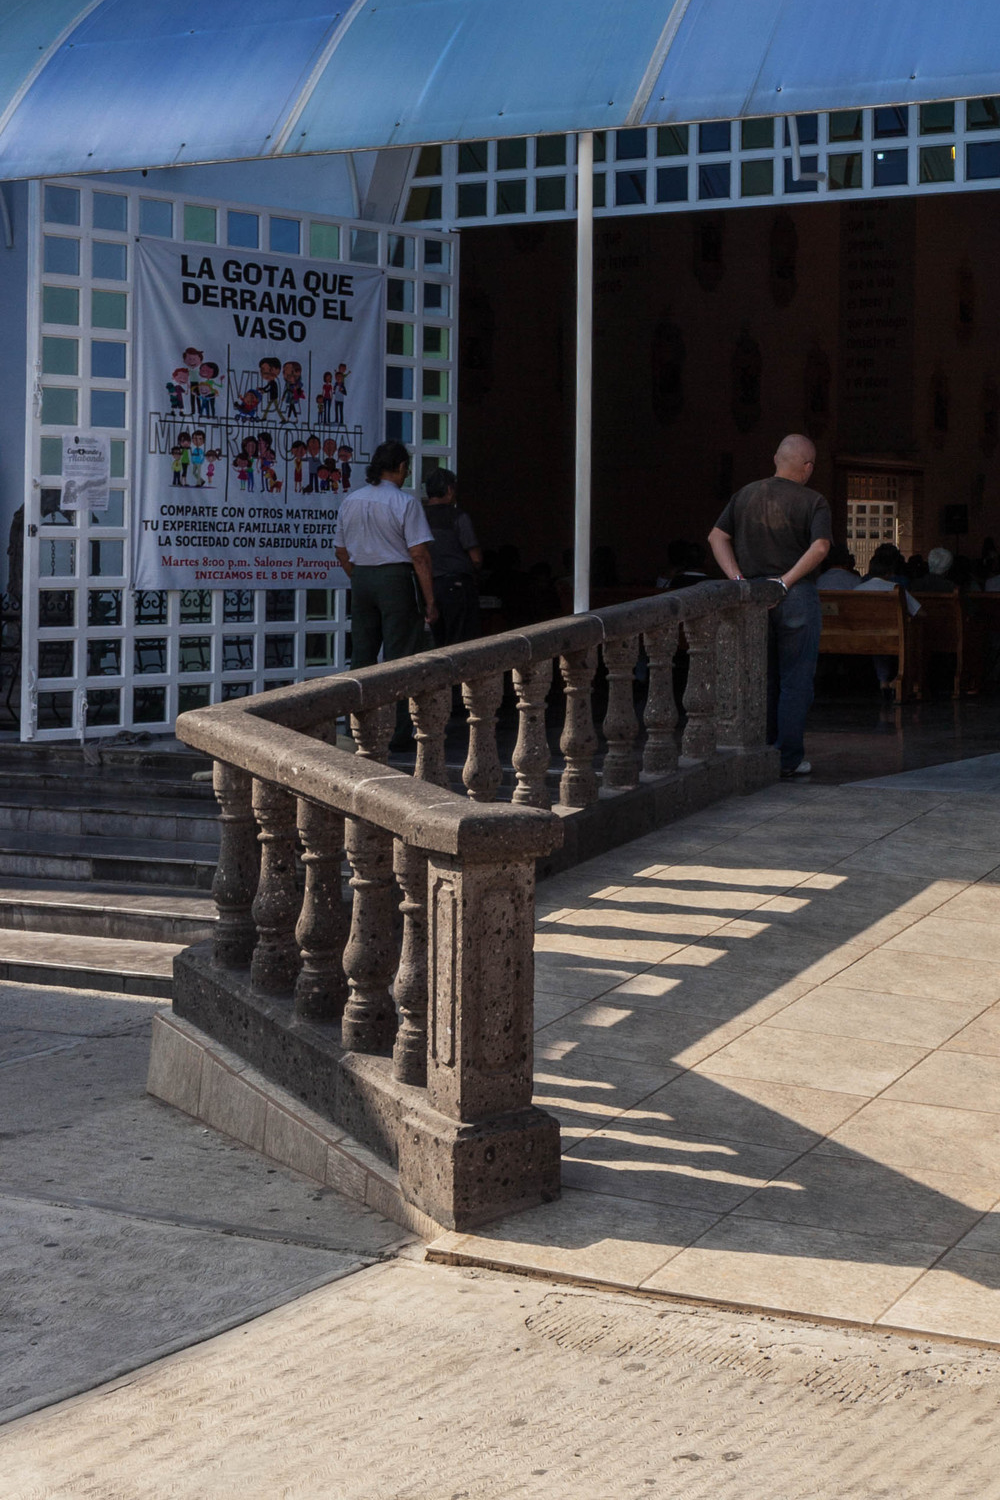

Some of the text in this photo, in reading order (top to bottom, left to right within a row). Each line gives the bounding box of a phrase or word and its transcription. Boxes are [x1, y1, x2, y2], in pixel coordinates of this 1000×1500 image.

[181, 254, 354, 297] LA GOTA QUE
[182, 282, 353, 322] DERRAMO EL
[233, 314, 307, 343] VASO
[160, 505, 338, 520] COMPARTE CON OTROS MATRIMON
[142, 520, 337, 535] TU EXPERIENCIA FAMILIAR Y EDIFIC
[158, 535, 172, 547] LA
[175, 536, 230, 548] SOCIEDAD
[233, 536, 256, 548] CON
[258, 535, 318, 549] SABIDURÍA
[161, 555, 199, 567] Martes
[202, 556, 225, 567] 8:00
[228, 558, 250, 570] p.m.
[254, 556, 293, 567] Salones
[195, 571, 328, 580] INICIAMOS EL 8 DE MAYO
